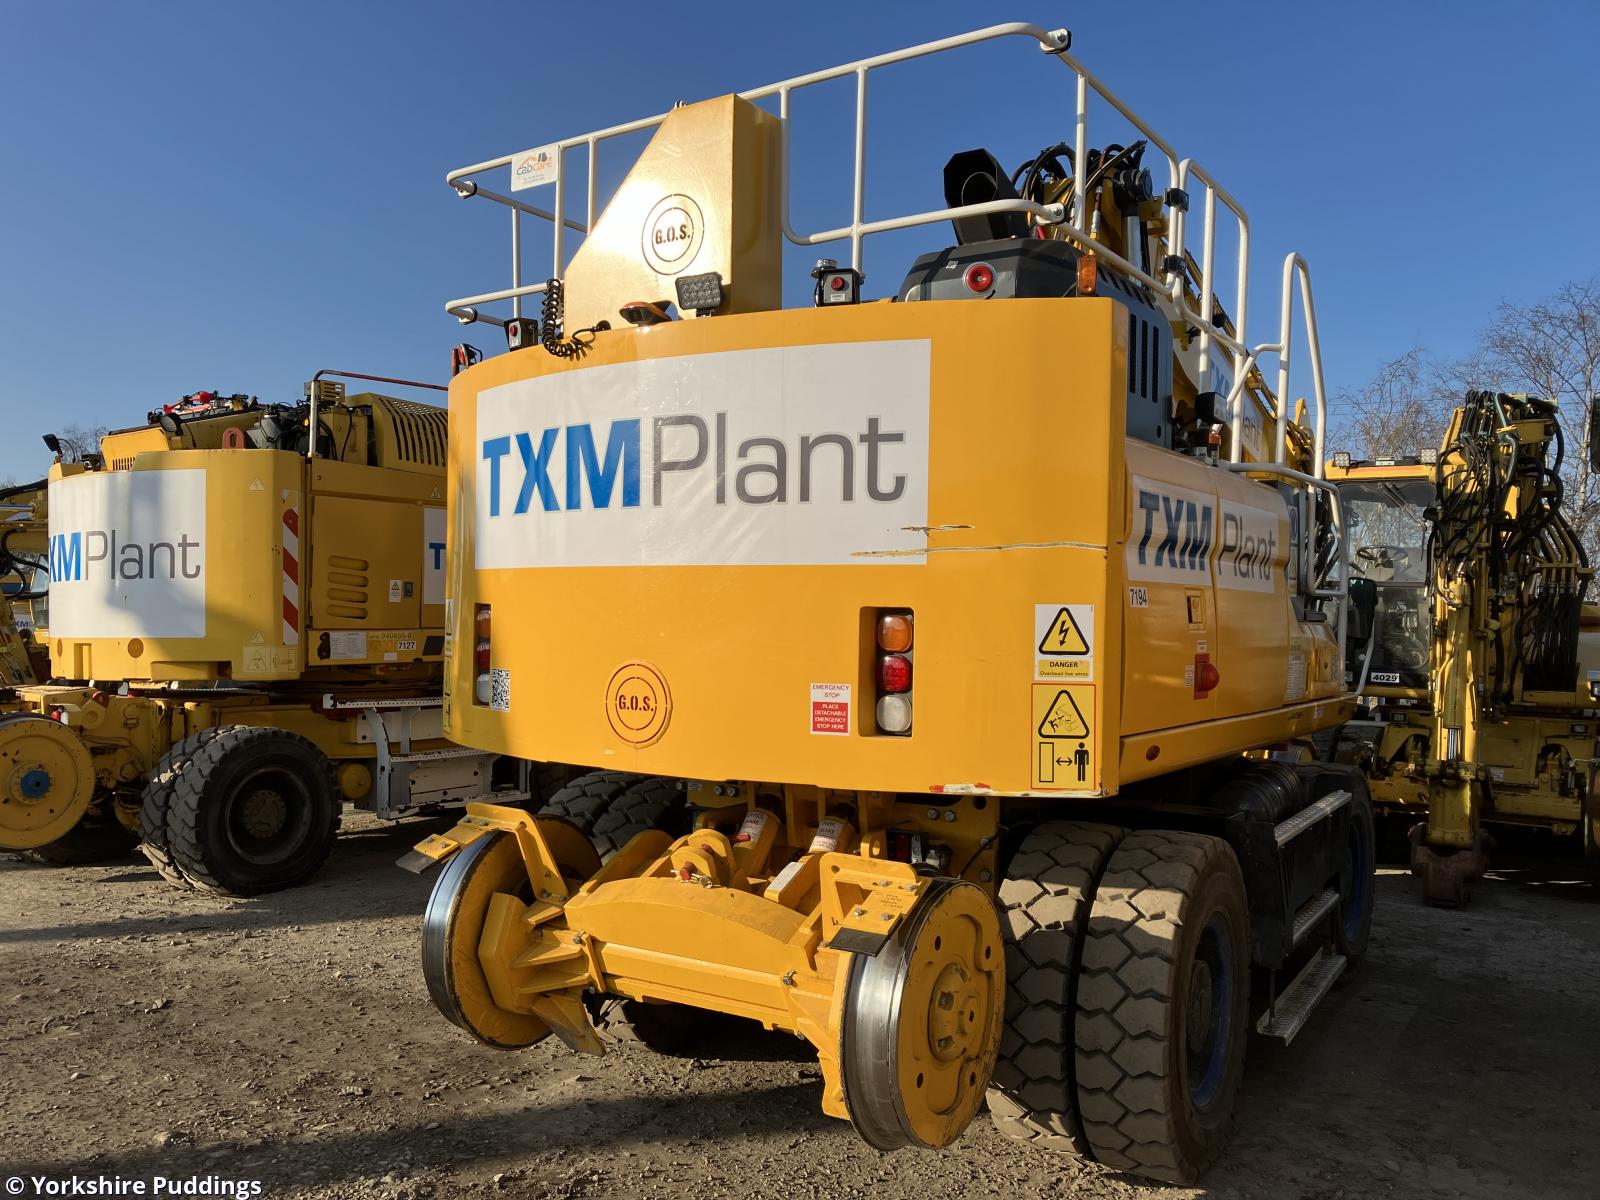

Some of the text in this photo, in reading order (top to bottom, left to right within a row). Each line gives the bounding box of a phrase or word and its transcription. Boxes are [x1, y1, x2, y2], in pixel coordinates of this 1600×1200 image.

[655, 223, 691, 245] G.O.S.
[1130, 588, 1147, 606] 7194
[399, 641, 416, 650] 7127
[1373, 674, 1397, 682] 4029
[618, 694, 655, 712] G.O.S.
